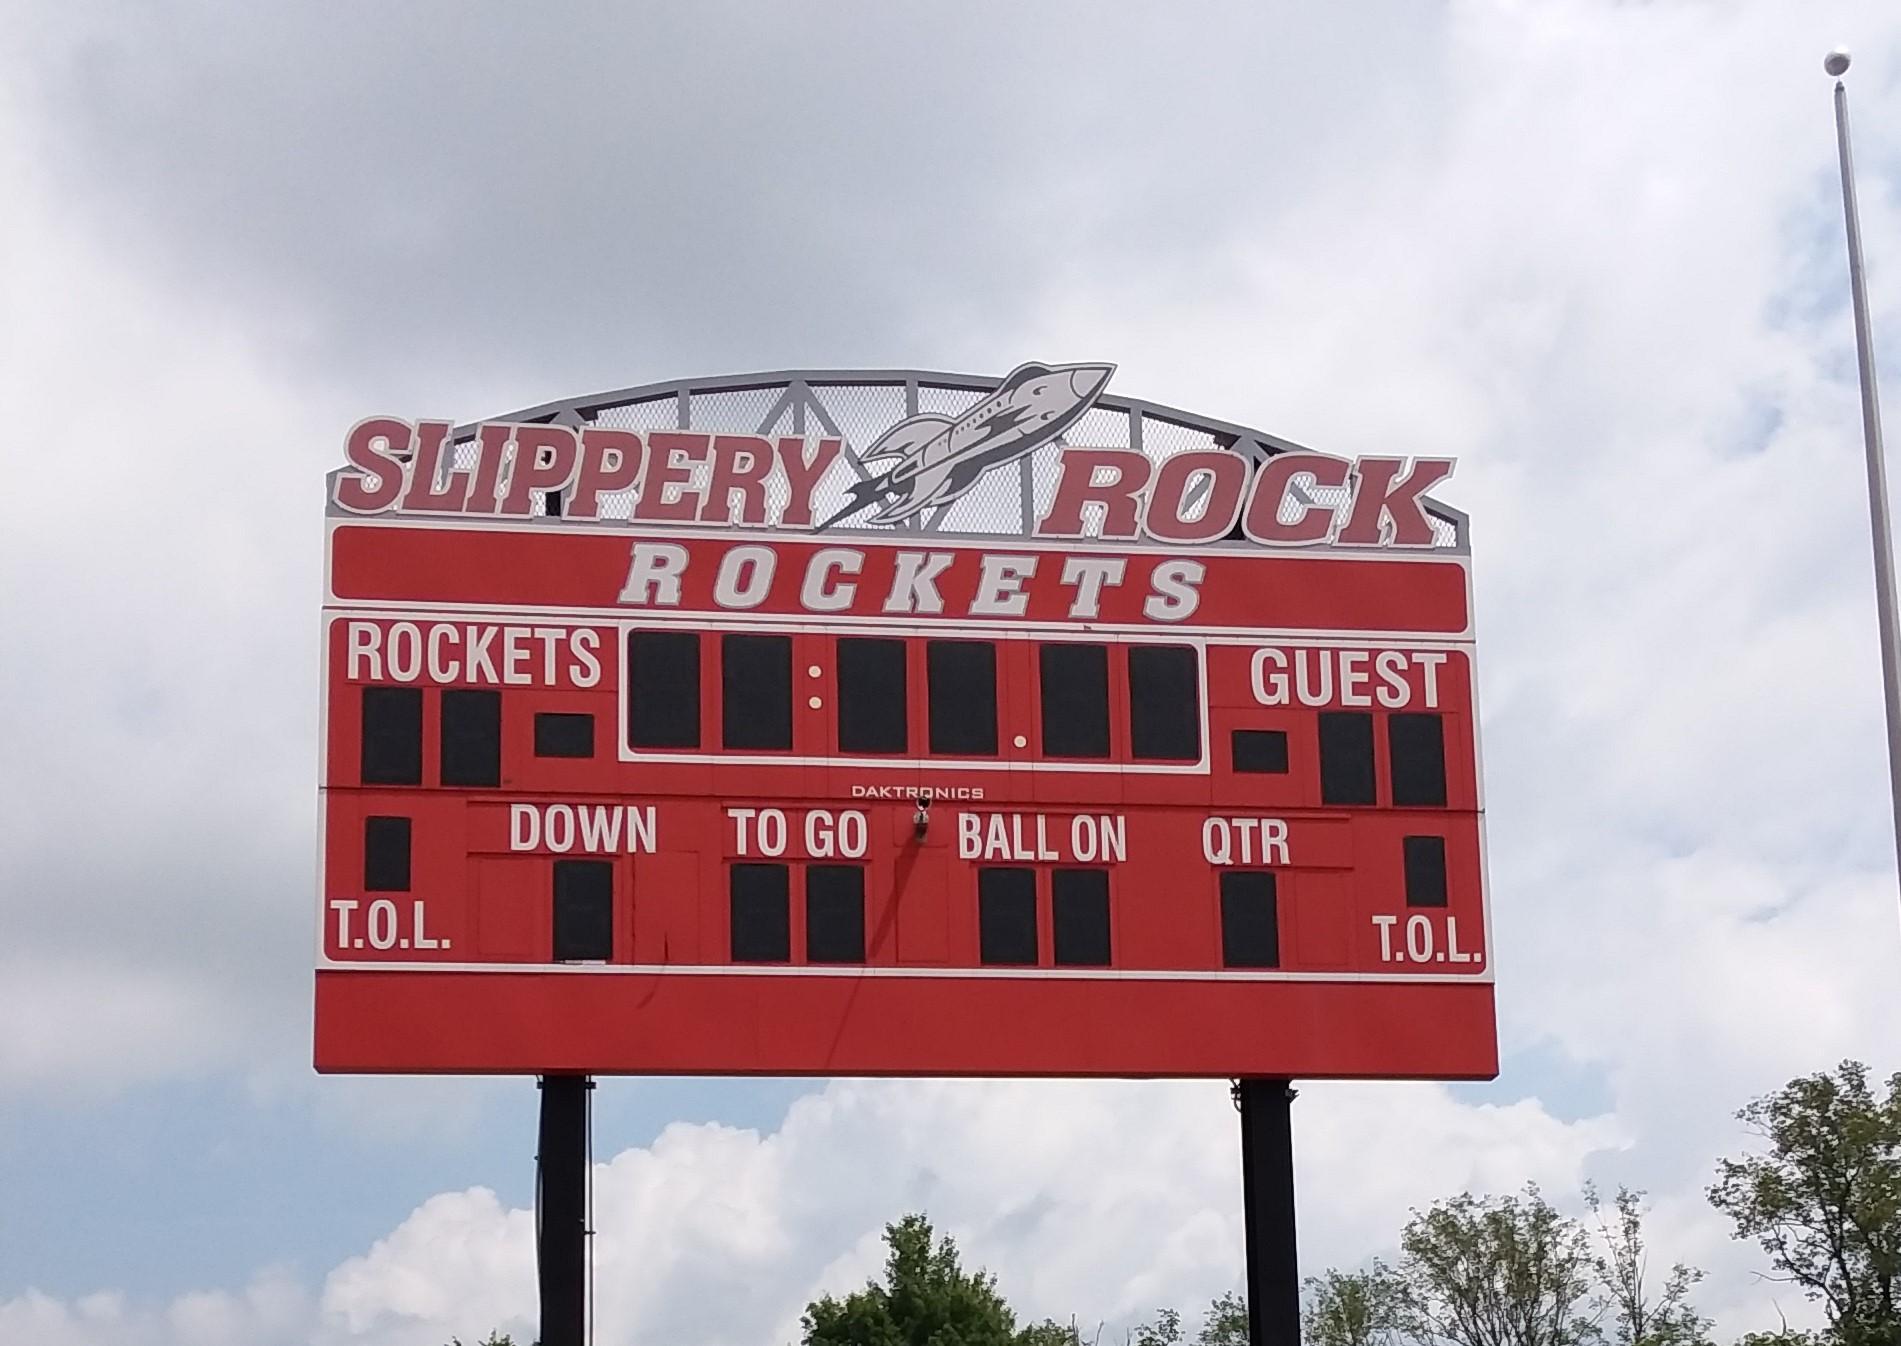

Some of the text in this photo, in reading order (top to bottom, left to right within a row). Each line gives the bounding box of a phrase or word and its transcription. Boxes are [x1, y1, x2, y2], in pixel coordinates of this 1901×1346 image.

[333, 416, 1458, 549] SLIPPERY ROCK
[616, 540, 1207, 621] ROCKETS
[346, 620, 602, 688] ROCKETS
[1250, 647, 1448, 709] GUEST
[851, 785, 985, 800] DAKTRONICS
[509, 803, 657, 854] DOWN
[727, 808, 869, 858] TO GO
[957, 812, 1128, 863] BALL ON
[1202, 817, 1291, 866] QTR
[329, 899, 452, 951] T.O.L.
[1371, 915, 1483, 965] T.O.L.
